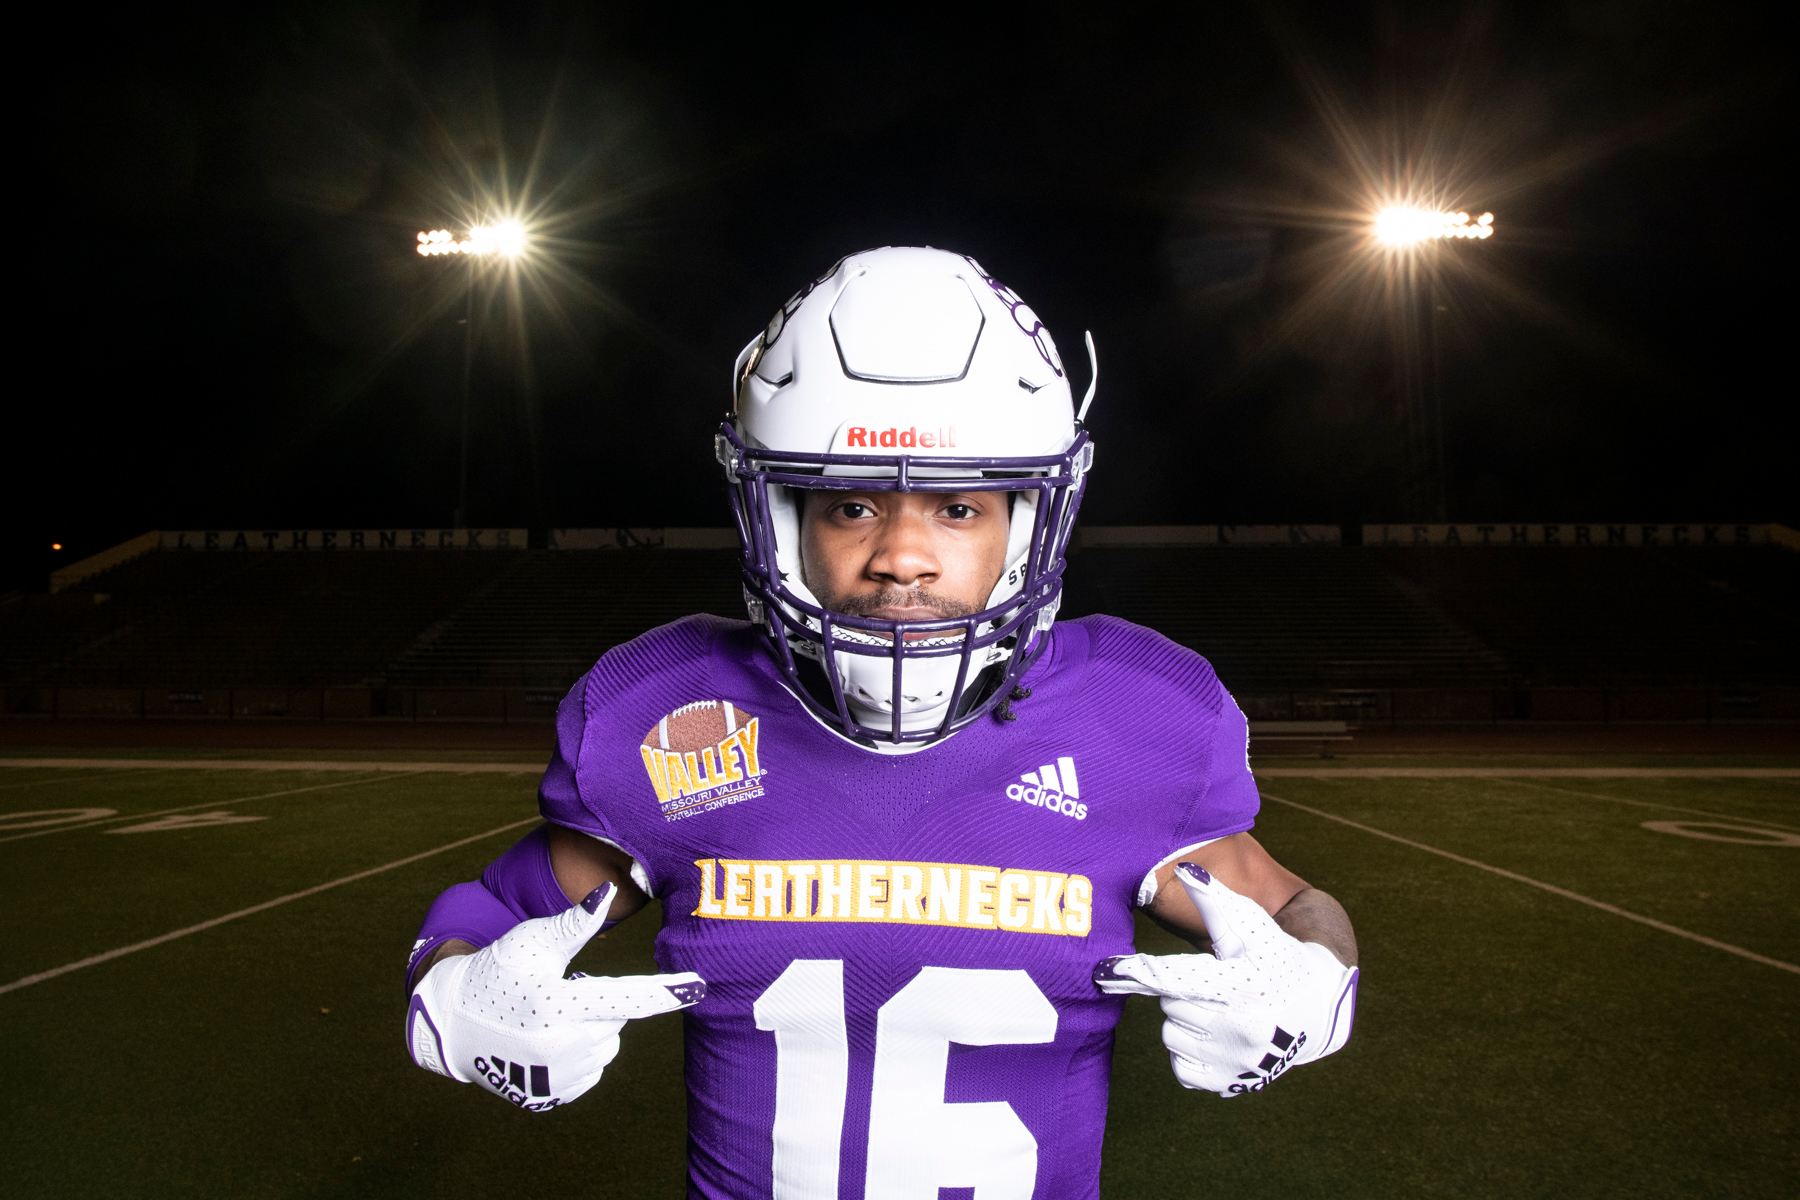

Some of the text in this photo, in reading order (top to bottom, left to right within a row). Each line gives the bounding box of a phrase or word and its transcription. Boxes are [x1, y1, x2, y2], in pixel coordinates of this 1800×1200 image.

[847, 426, 957, 448] Riddell
[178, 531, 513, 551] LEATHERNECKS
[1382, 525, 1751, 546] LEATHERNECKS
[640, 717, 760, 804] VALLEY
[661, 777, 761, 813] MISSOURI VALLEY
[665, 787, 765, 822] FOOTBALL CONFERENCE
[1005, 784, 1088, 820] adidas
[693, 859, 1093, 937] LEATHERNECKS
[752, 959, 1059, 1200] 16
[1228, 1031, 1307, 1093] adidas
[474, 1056, 561, 1111] adidas
